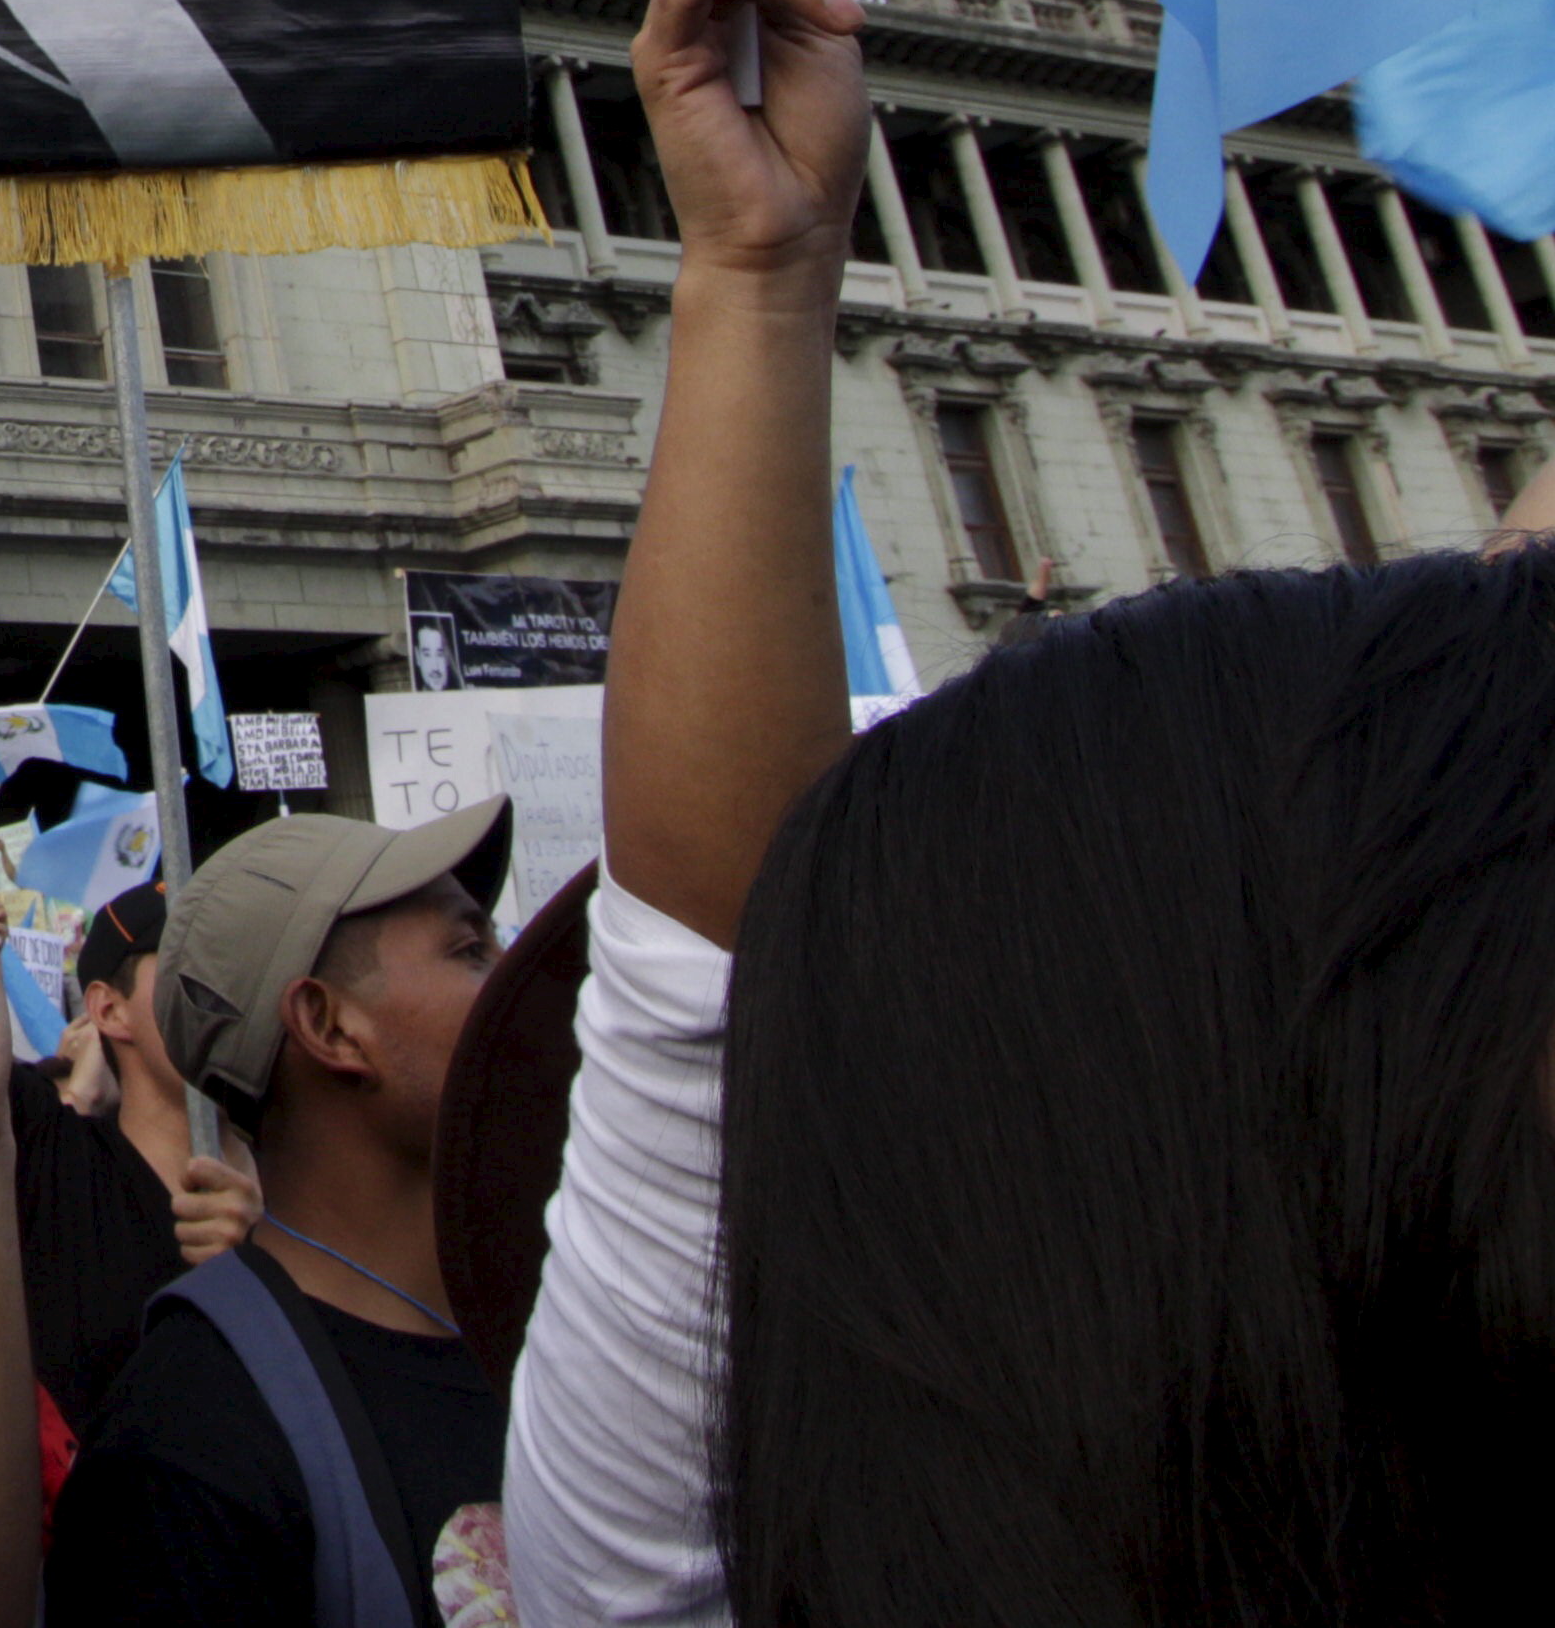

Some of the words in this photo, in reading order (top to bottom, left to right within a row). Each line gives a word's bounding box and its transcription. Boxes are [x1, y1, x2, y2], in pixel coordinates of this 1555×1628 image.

[521, 631, 546, 649] LOS
[382, 728, 452, 768] TE
[389, 781, 460, 815] TO
